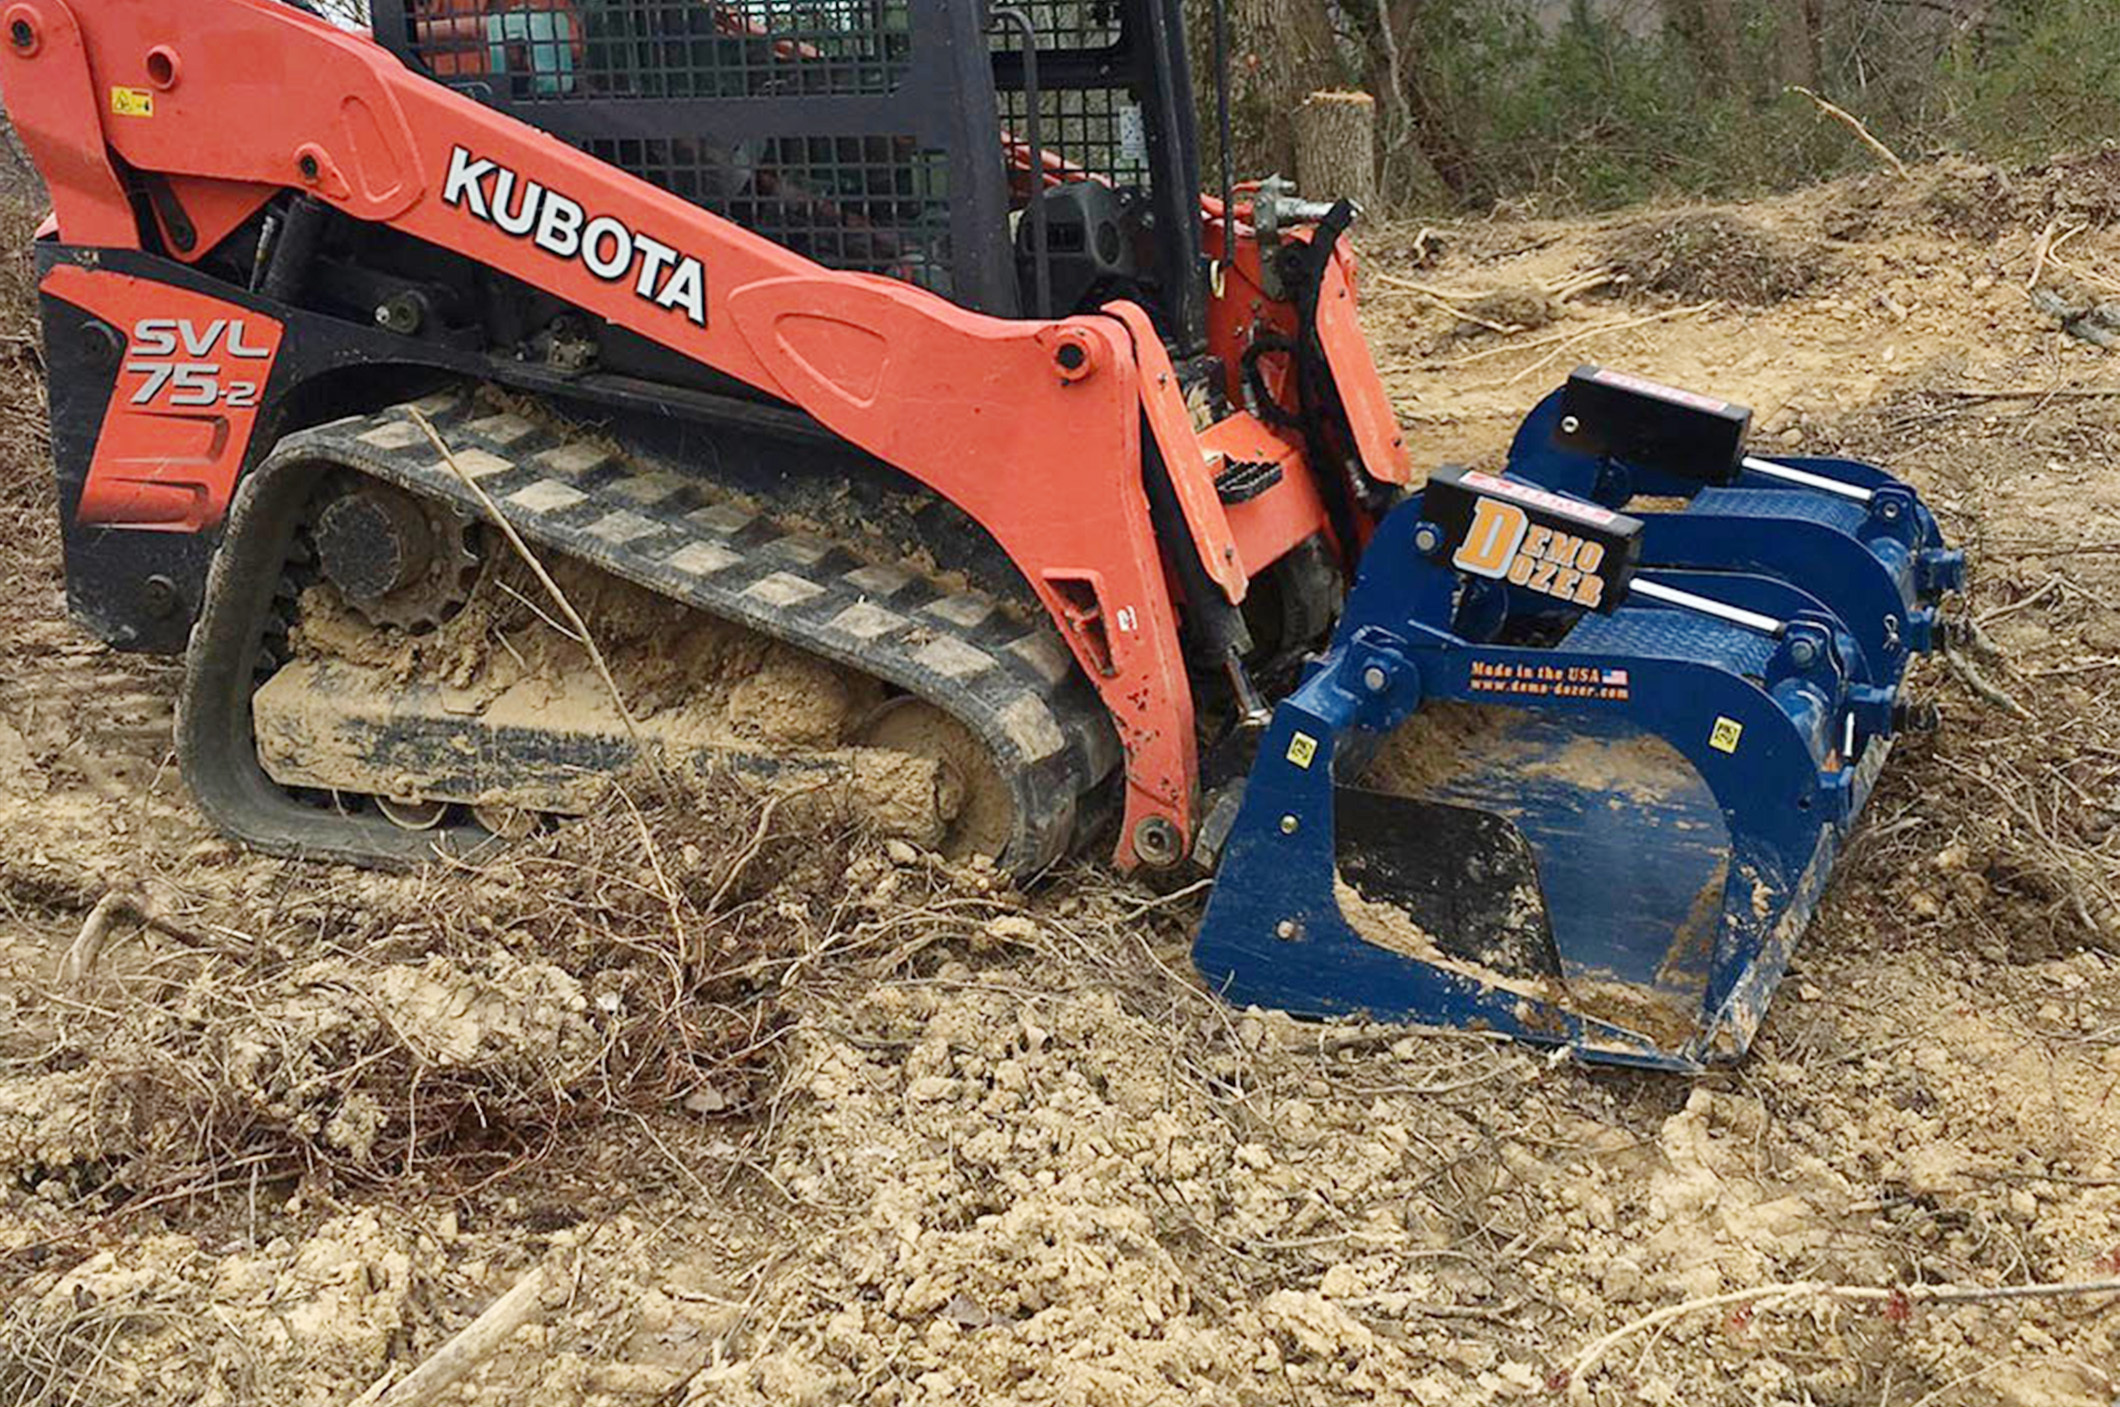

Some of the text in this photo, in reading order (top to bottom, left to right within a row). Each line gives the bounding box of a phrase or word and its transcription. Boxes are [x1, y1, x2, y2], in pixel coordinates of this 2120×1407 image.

[442, 145, 708, 328] KUBOTA
[131, 318, 270, 358] SVL
[126, 362, 256, 406] 75-2
[1470, 661, 1600, 683] Made in the USA
[1470, 679, 1629, 700] www.demo-dozer.com
